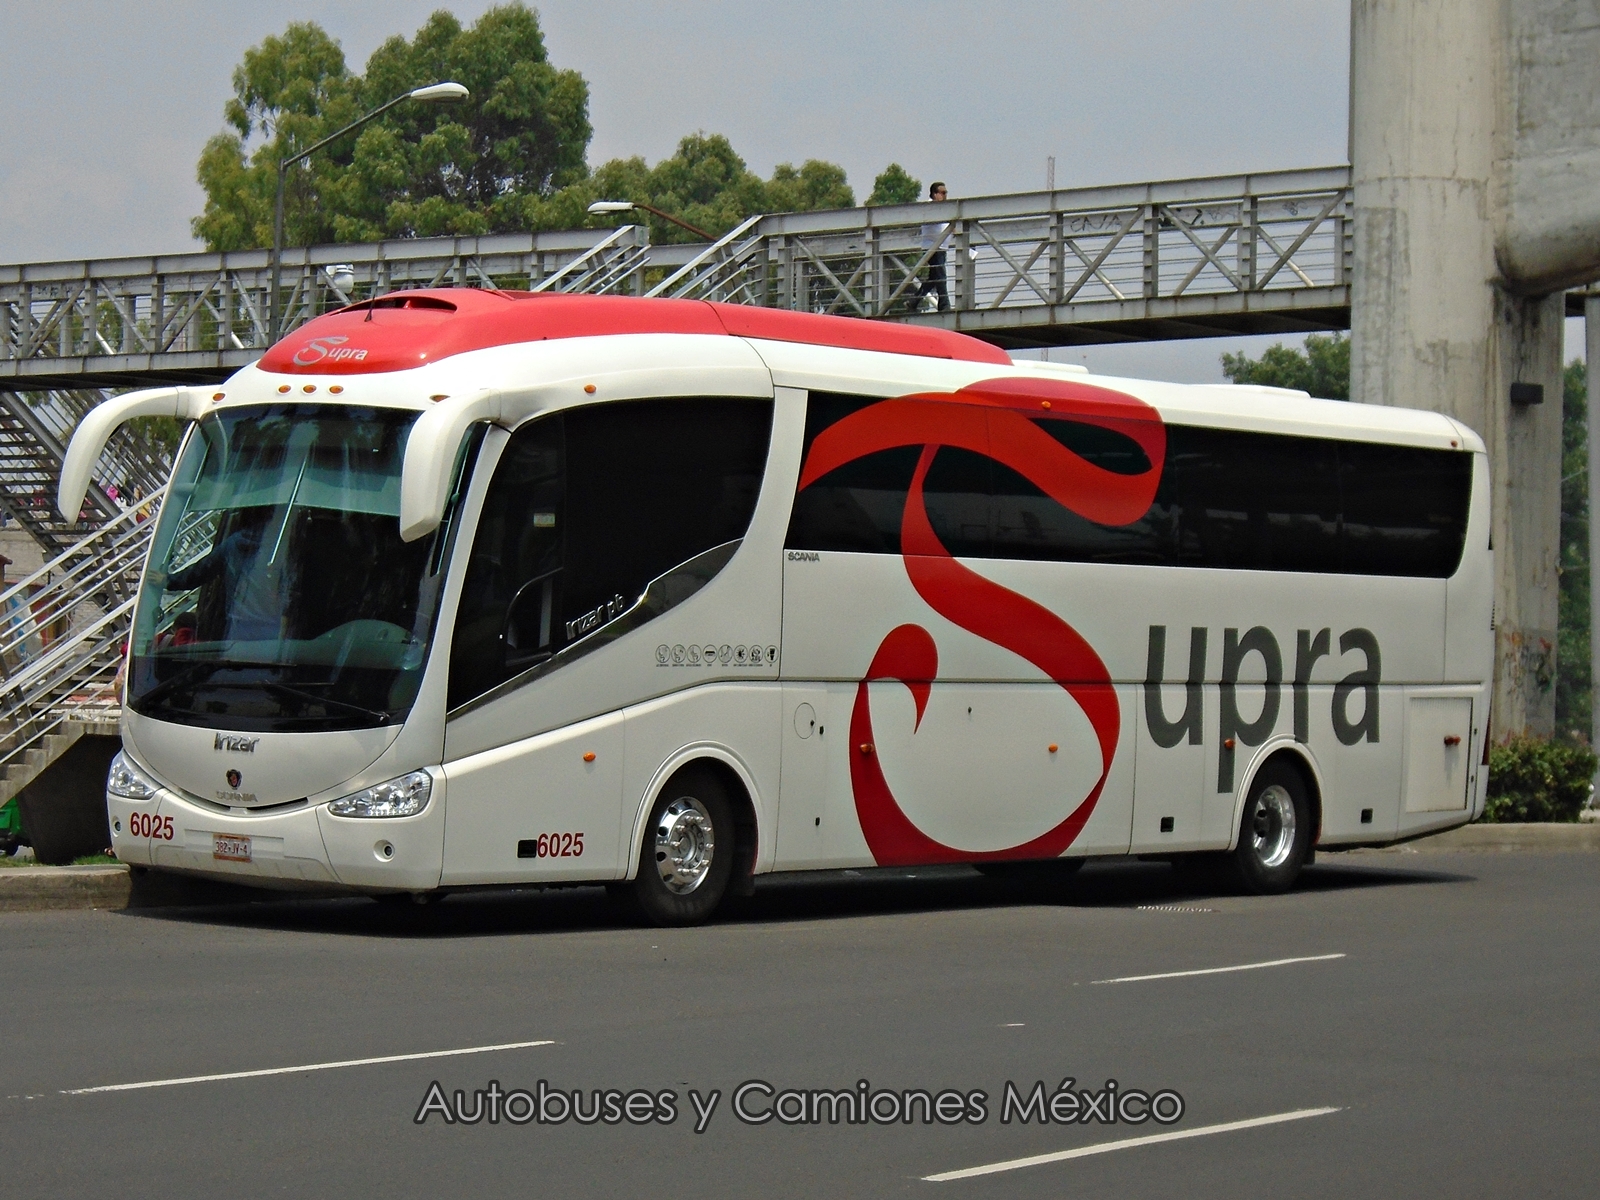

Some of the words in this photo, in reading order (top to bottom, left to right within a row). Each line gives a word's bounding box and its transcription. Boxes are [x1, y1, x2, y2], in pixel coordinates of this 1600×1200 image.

[293, 335, 368, 366] Supra
[787, 551, 820, 562] SCANIA
[798, 377, 1382, 867] Supra
[130, 811, 175, 841] 6025
[536, 832, 585, 858] 6025
